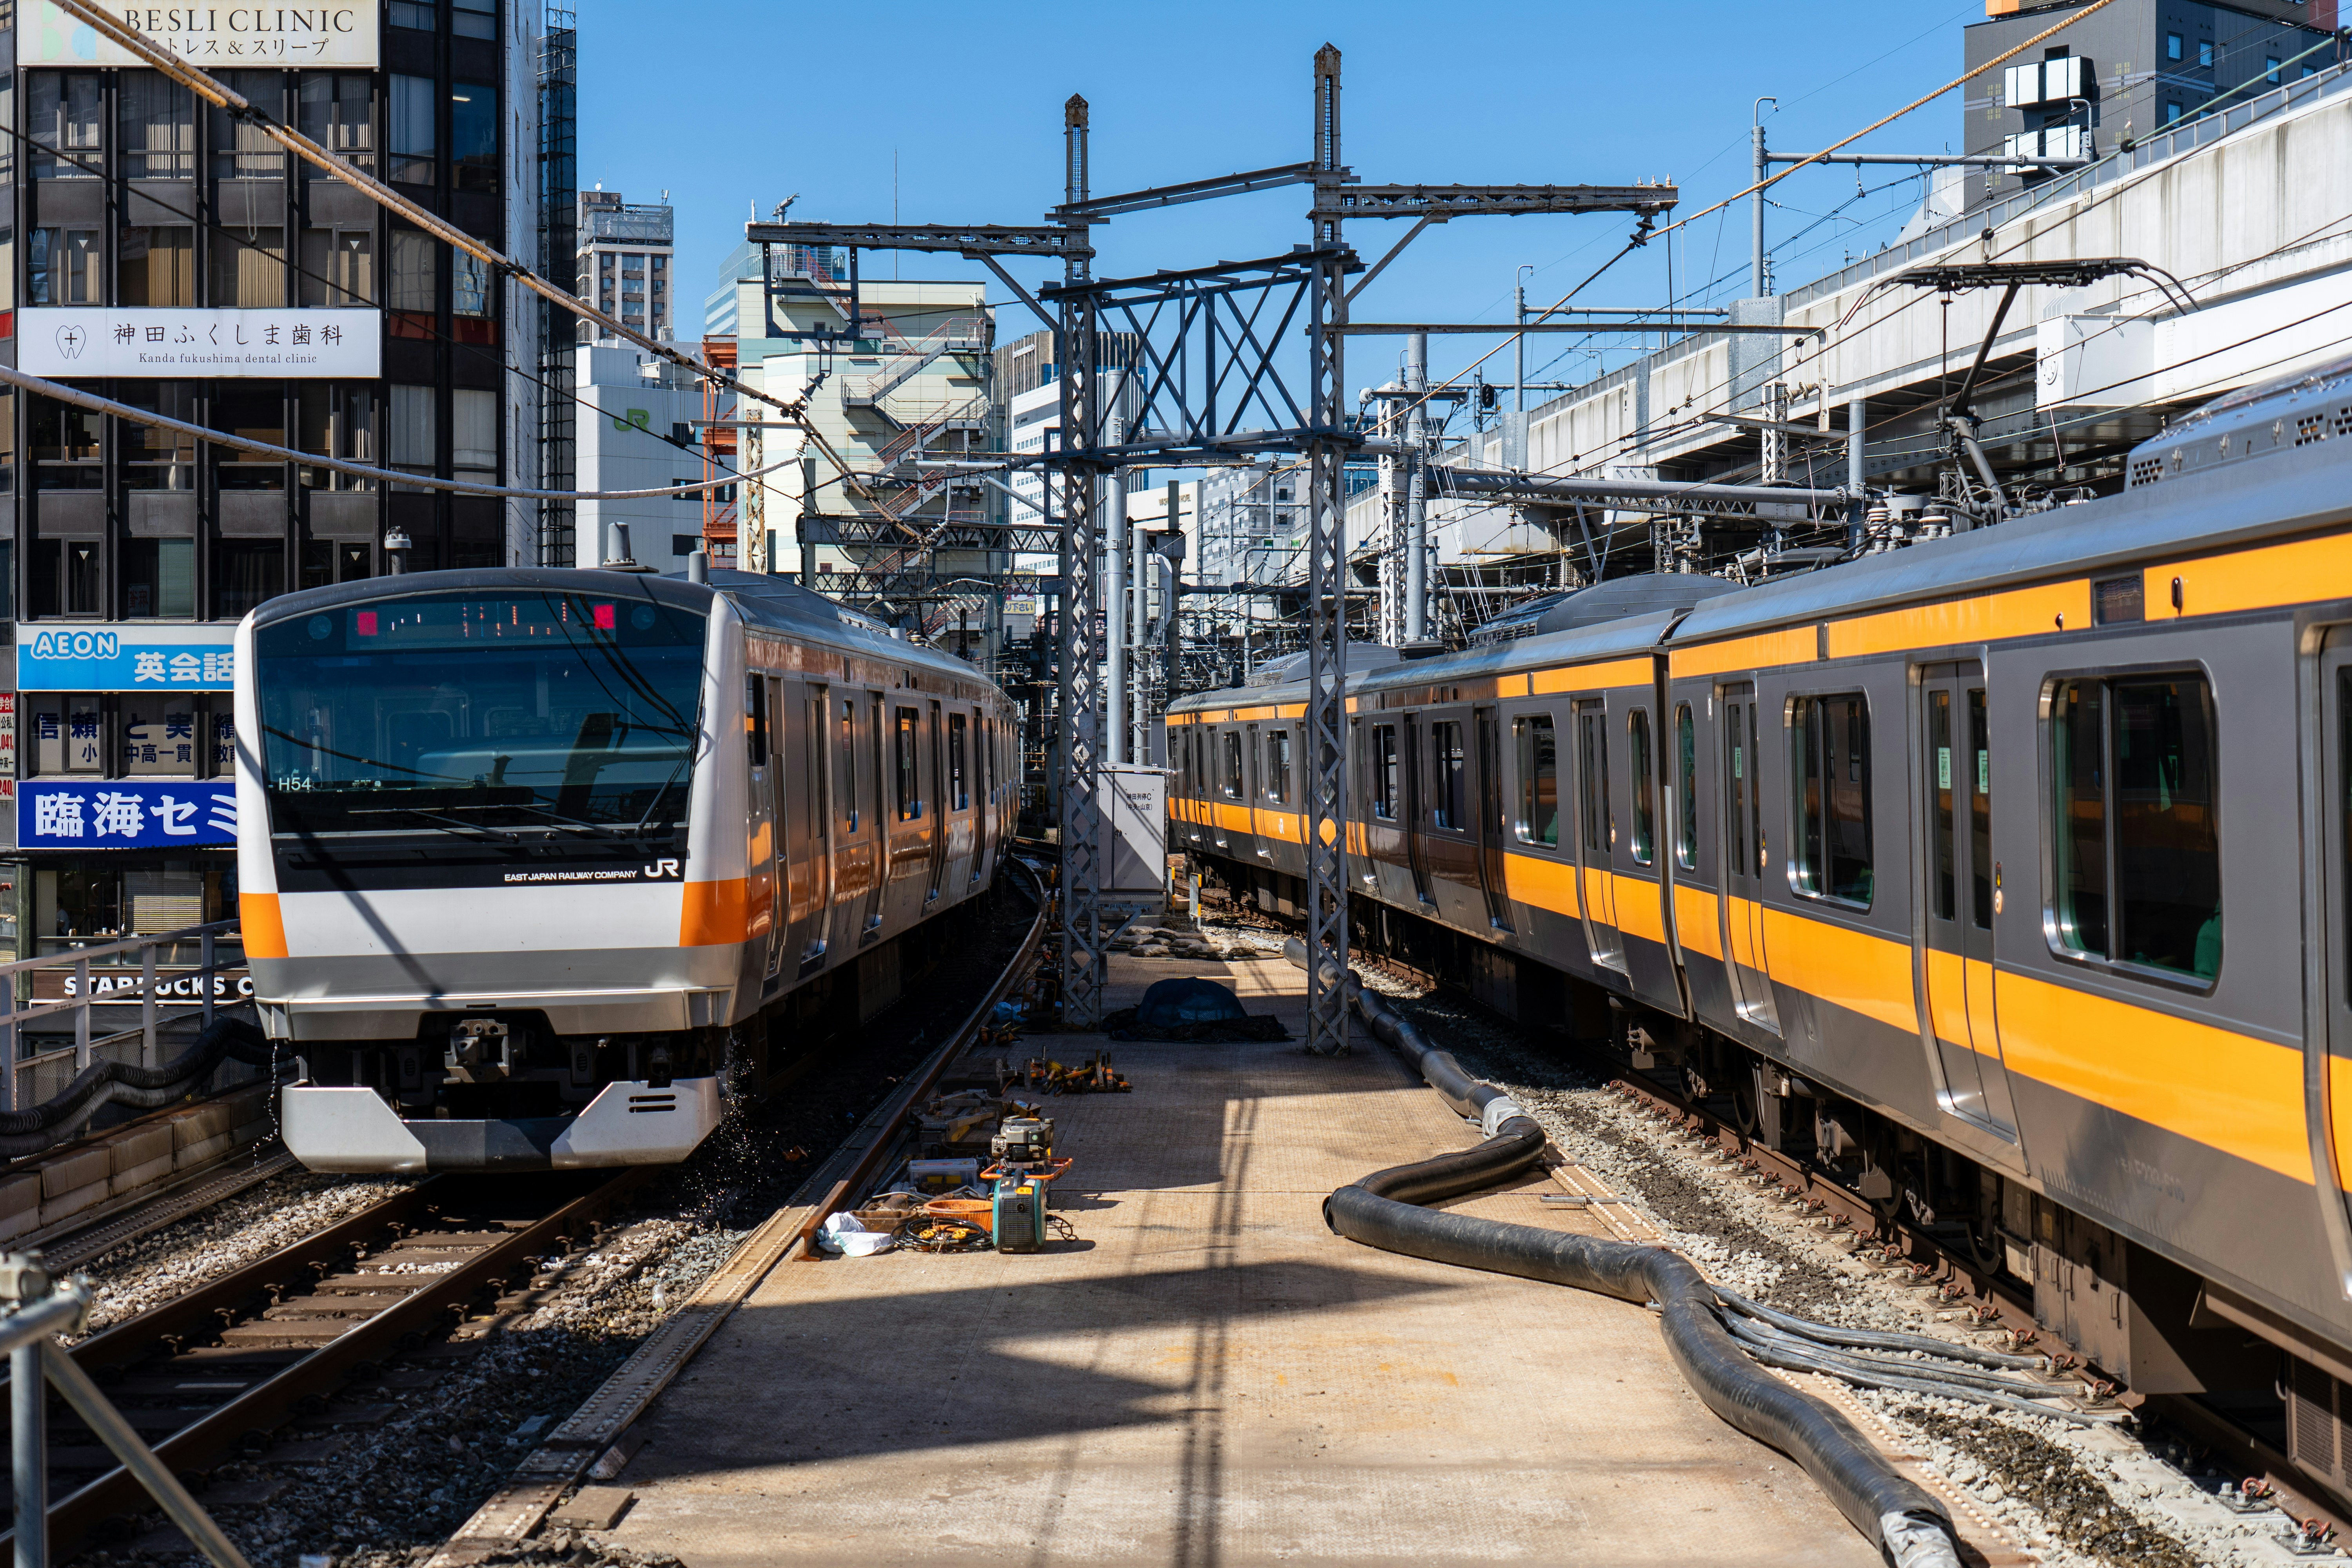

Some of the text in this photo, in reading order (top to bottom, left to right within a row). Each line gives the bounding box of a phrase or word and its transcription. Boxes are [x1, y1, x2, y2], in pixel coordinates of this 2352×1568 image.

[124, 9, 353, 32] BESLI CLINIC
[113, 323, 343, 347] 神田ふくしま歯科
[139, 352, 317, 363] Kanda fukushima dental clinic
[614, 409, 649, 431] JR
[34, 633, 116, 656] AEON
[134, 652, 234, 682] 英会話
[1708, 697, 1711, 717] 8
[279, 777, 311, 791] H54
[35, 792, 238, 837] 臨海セミ
[1278, 818, 1285, 835] JR
[505, 870, 637, 882] EAST JAPAN RAILWAY COMPANY
[644, 858, 679, 877] JR
